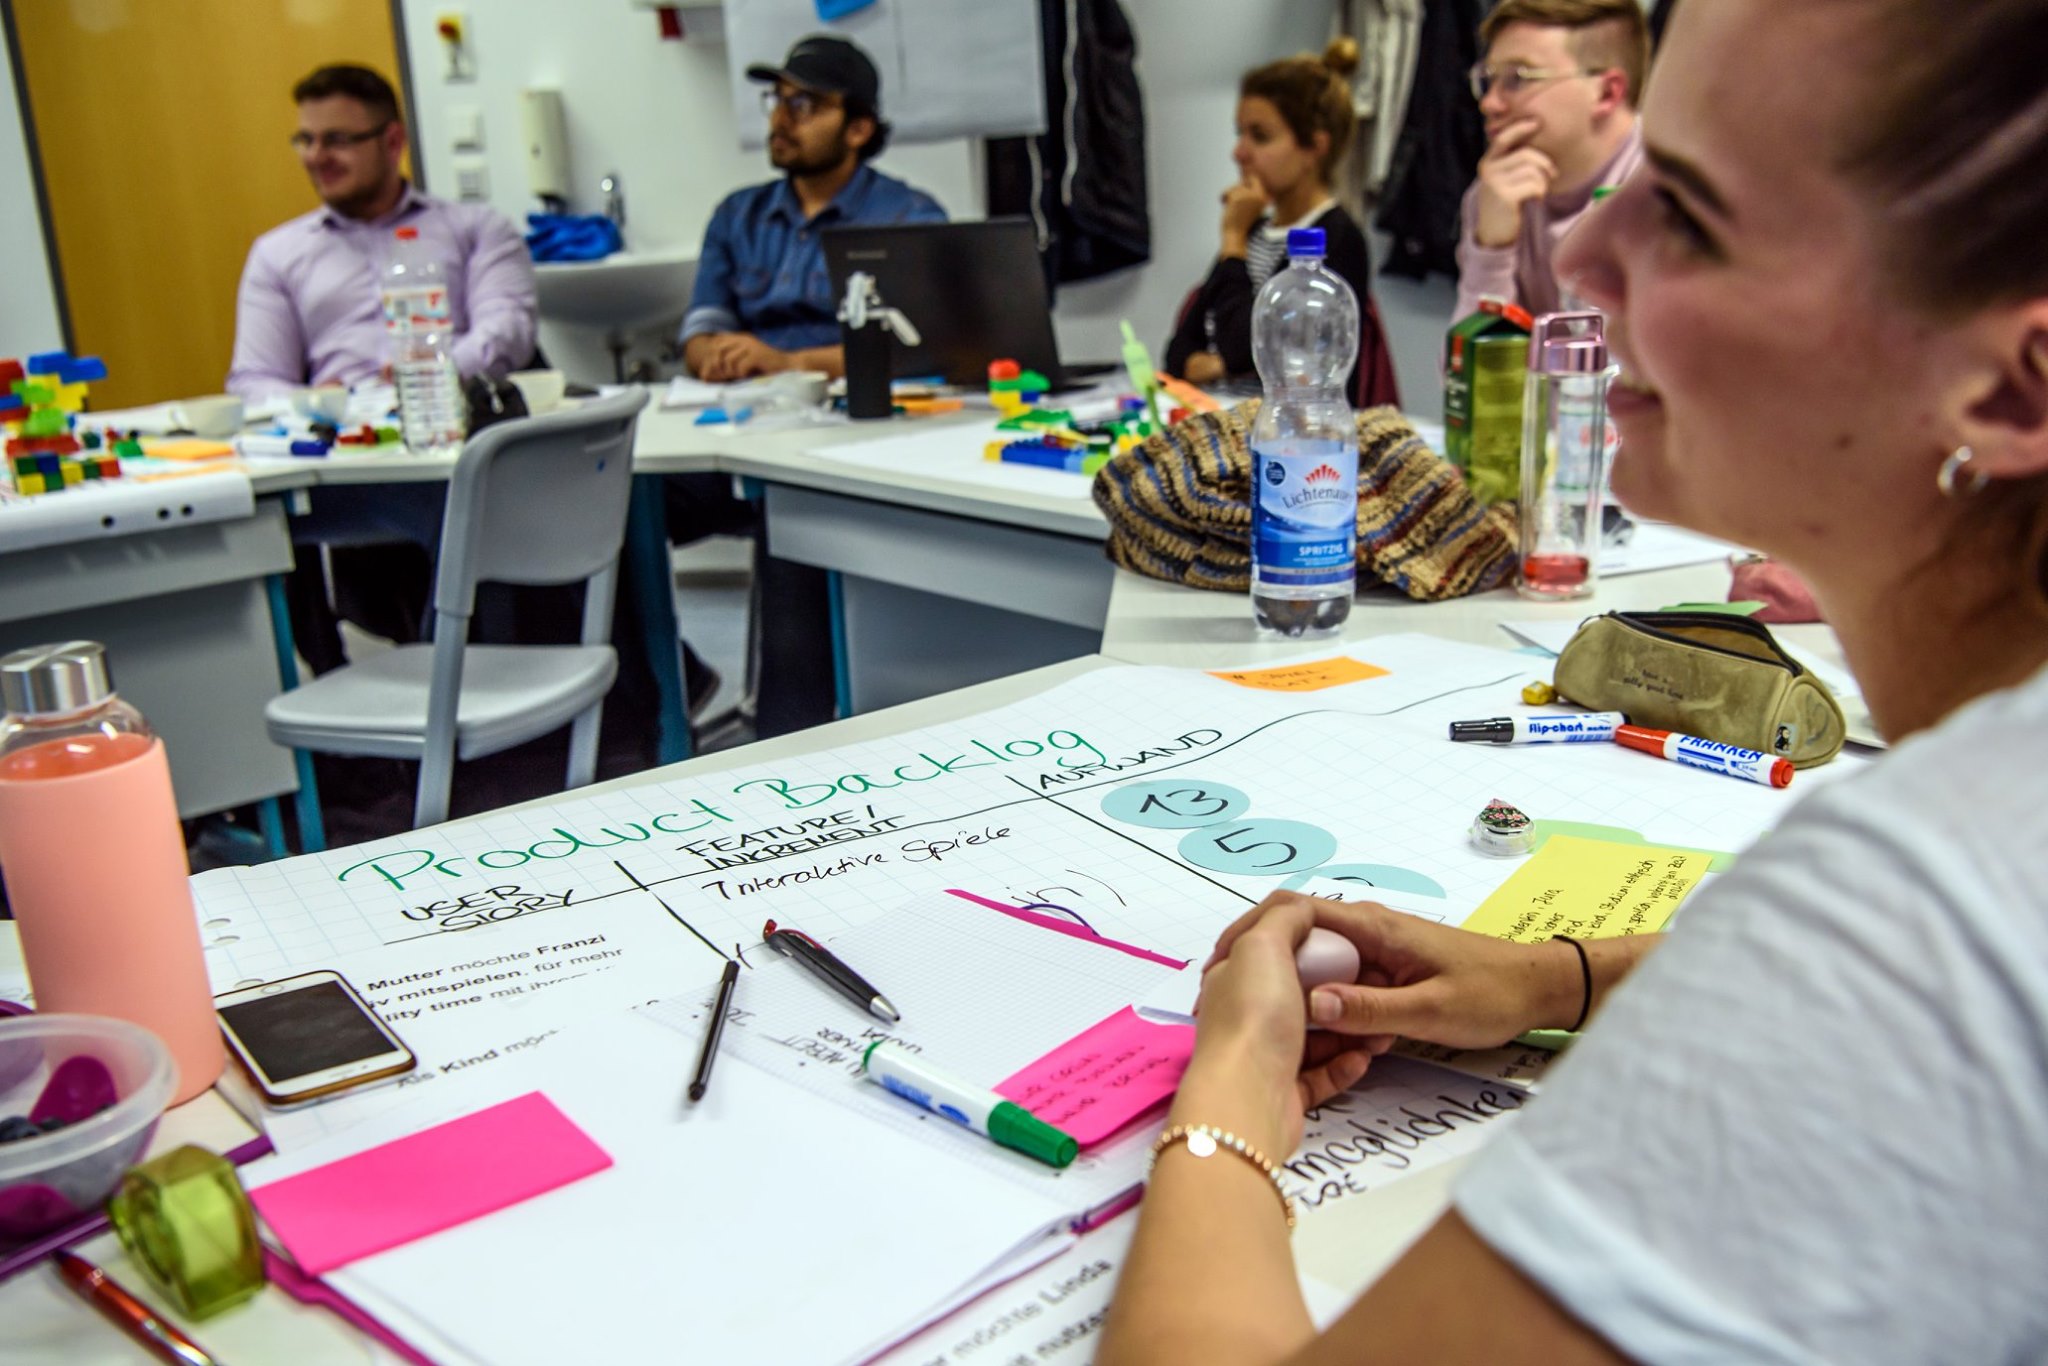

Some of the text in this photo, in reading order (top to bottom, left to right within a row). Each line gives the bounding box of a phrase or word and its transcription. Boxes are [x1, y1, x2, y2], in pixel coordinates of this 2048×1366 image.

[1299, 543, 1344, 556] SPRITZIG
[1039, 729, 1223, 790] AUFWAND
[337, 729, 1107, 891] Product Backlog
[1138, 788, 1229, 817] 13
[703, 815, 906, 871] INKREMENT
[900, 825, 1012, 863] Spiele
[1213, 827, 1298, 868] 5
[400, 885, 535, 921] USER
[367, 933, 607, 992] Mutter möchte Franzi
[534, 960, 563, 973] für
[569, 946, 624, 966] mehr
[429, 994, 483, 1013] time
[489, 985, 525, 1000] mit
[439, 1048, 500, 1074] Kind
